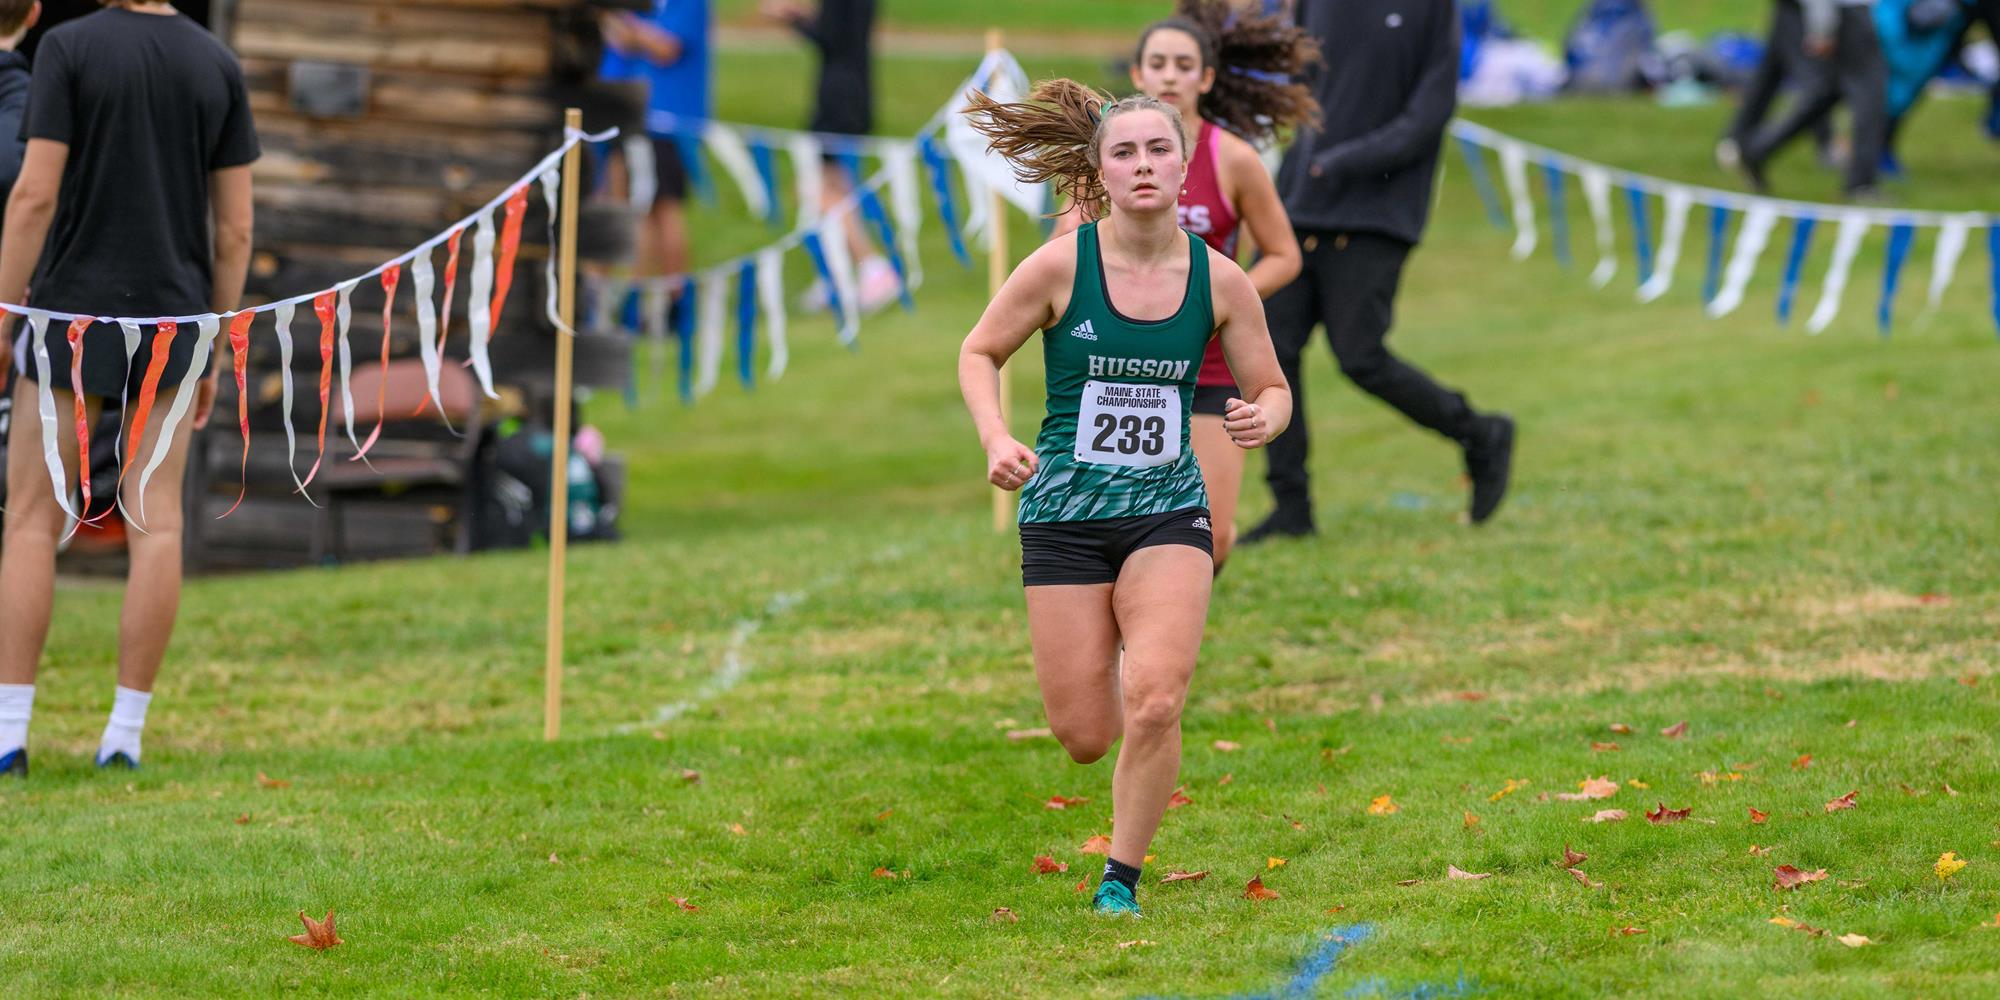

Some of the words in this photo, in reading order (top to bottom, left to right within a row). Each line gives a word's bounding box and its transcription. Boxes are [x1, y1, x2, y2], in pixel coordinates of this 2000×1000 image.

[1071, 330, 1098, 341] adidas
[1088, 355, 1190, 380] HUSSON
[1105, 386, 1133, 397] MAINE
[1135, 388, 1161, 398] STATE
[1096, 396, 1167, 409] CHAMPIONSHIPS
[1091, 413, 1166, 456] 233
[1192, 522, 1211, 531] adida
